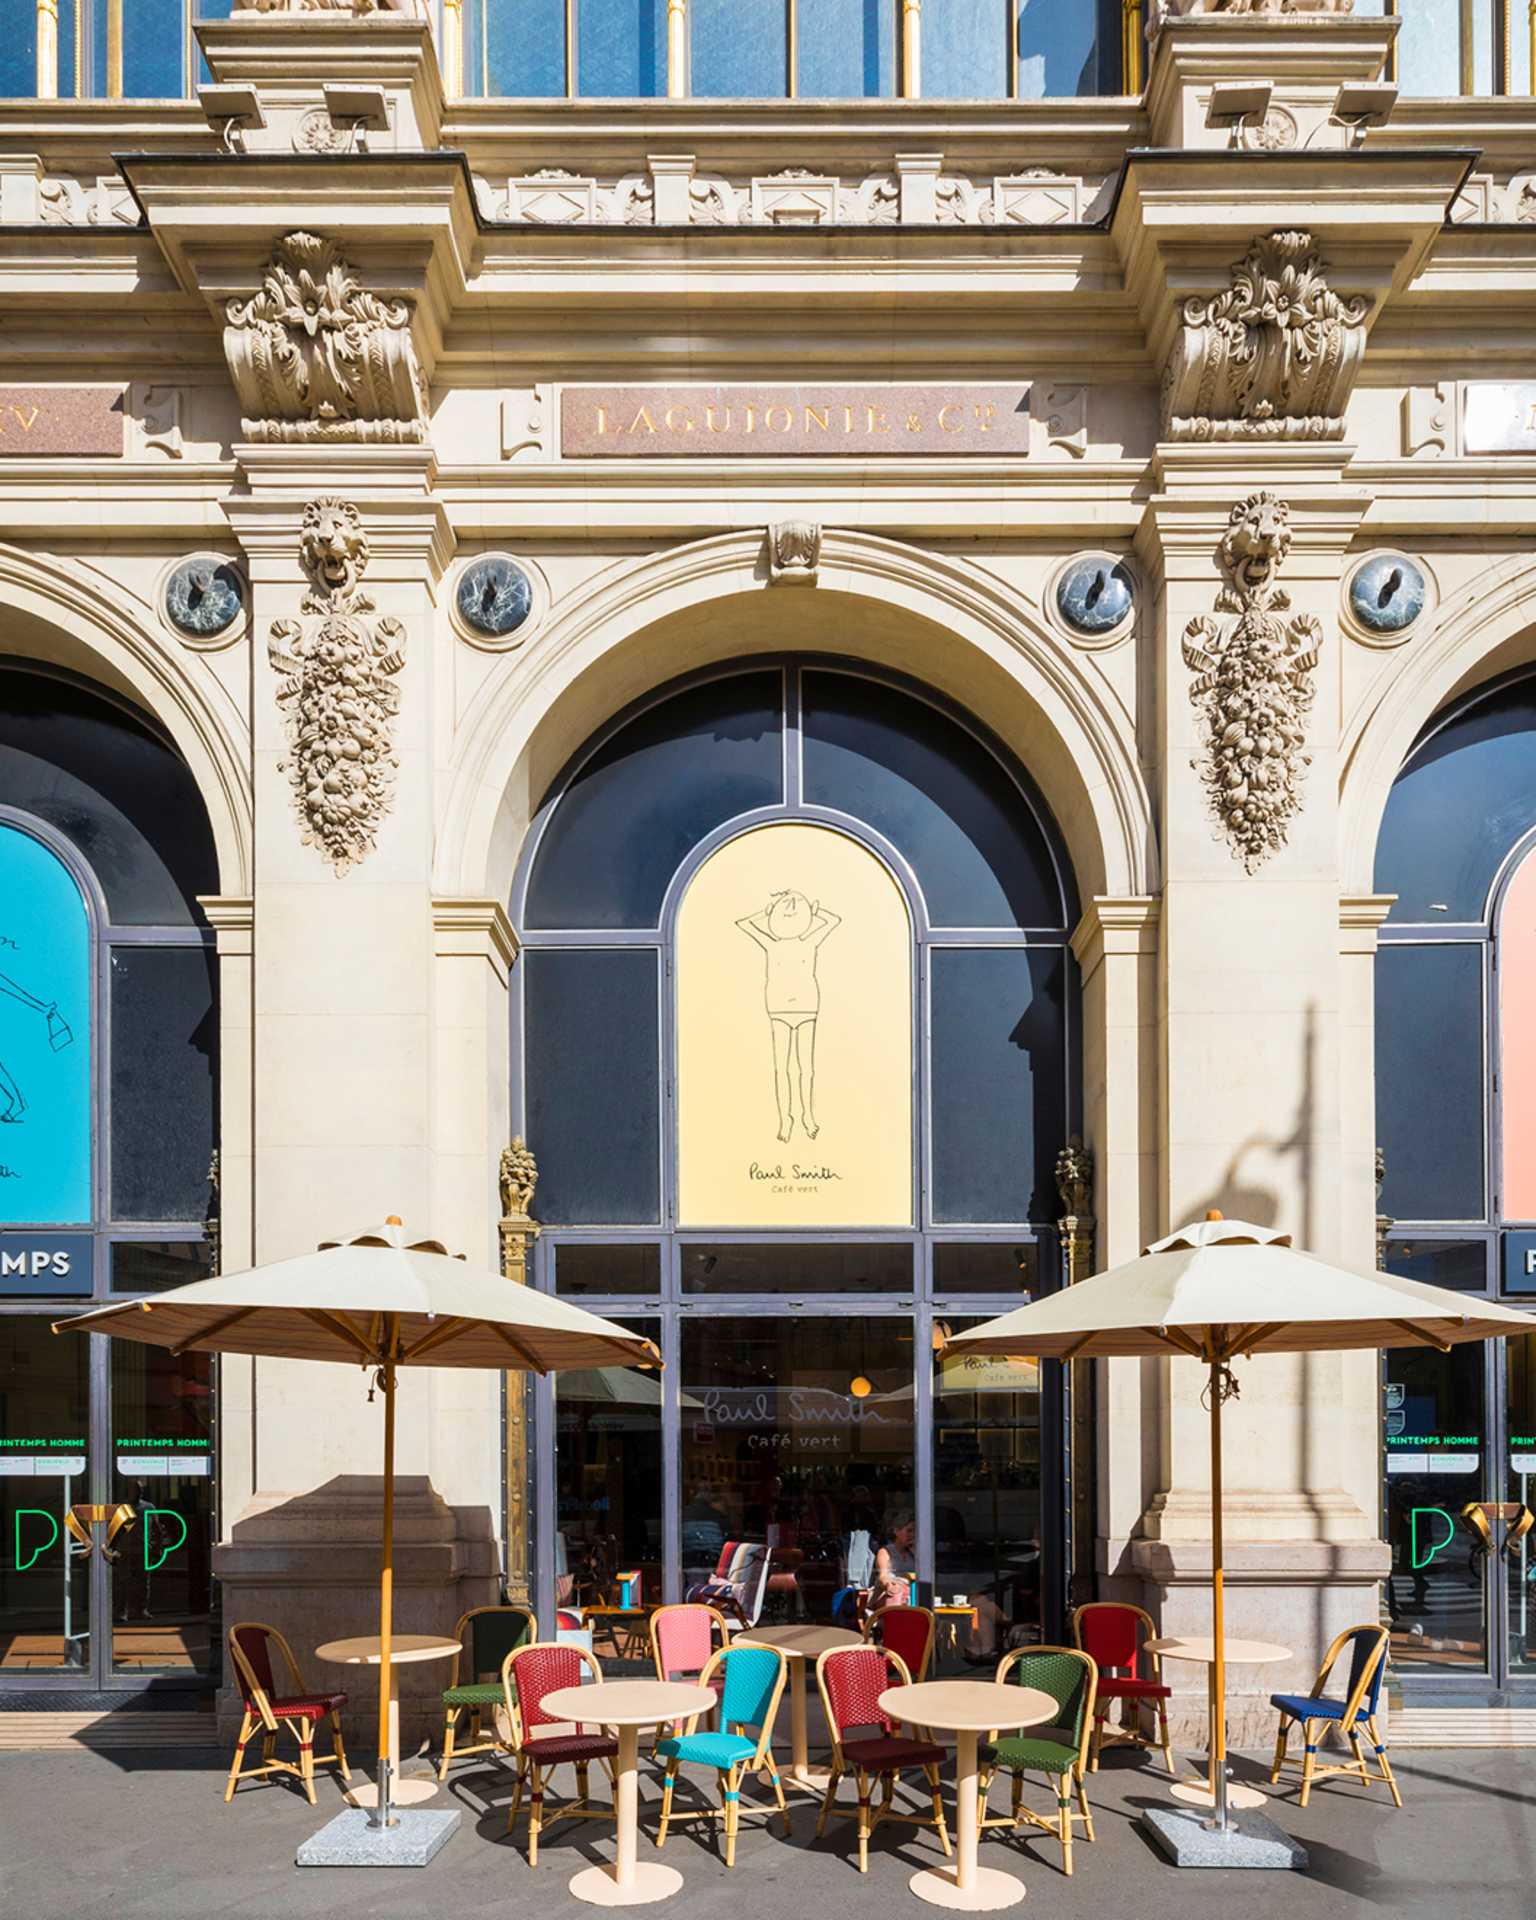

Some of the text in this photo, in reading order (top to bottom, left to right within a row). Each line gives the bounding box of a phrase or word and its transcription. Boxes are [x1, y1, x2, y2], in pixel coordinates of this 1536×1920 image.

[593, 402, 891, 434] LAGUIONIE
[905, 412, 923, 433] &
[749, 1162, 843, 1180] Paul Smith
[703, 1390, 890, 1423] Paul Smith
[50, 1439, 85, 1447] HOMME
[117, 1439, 174, 1447] PRINTEMPS
[747, 1432, 841, 1448] Café vert
[1443, 1437, 1479, 1445] HOMME
